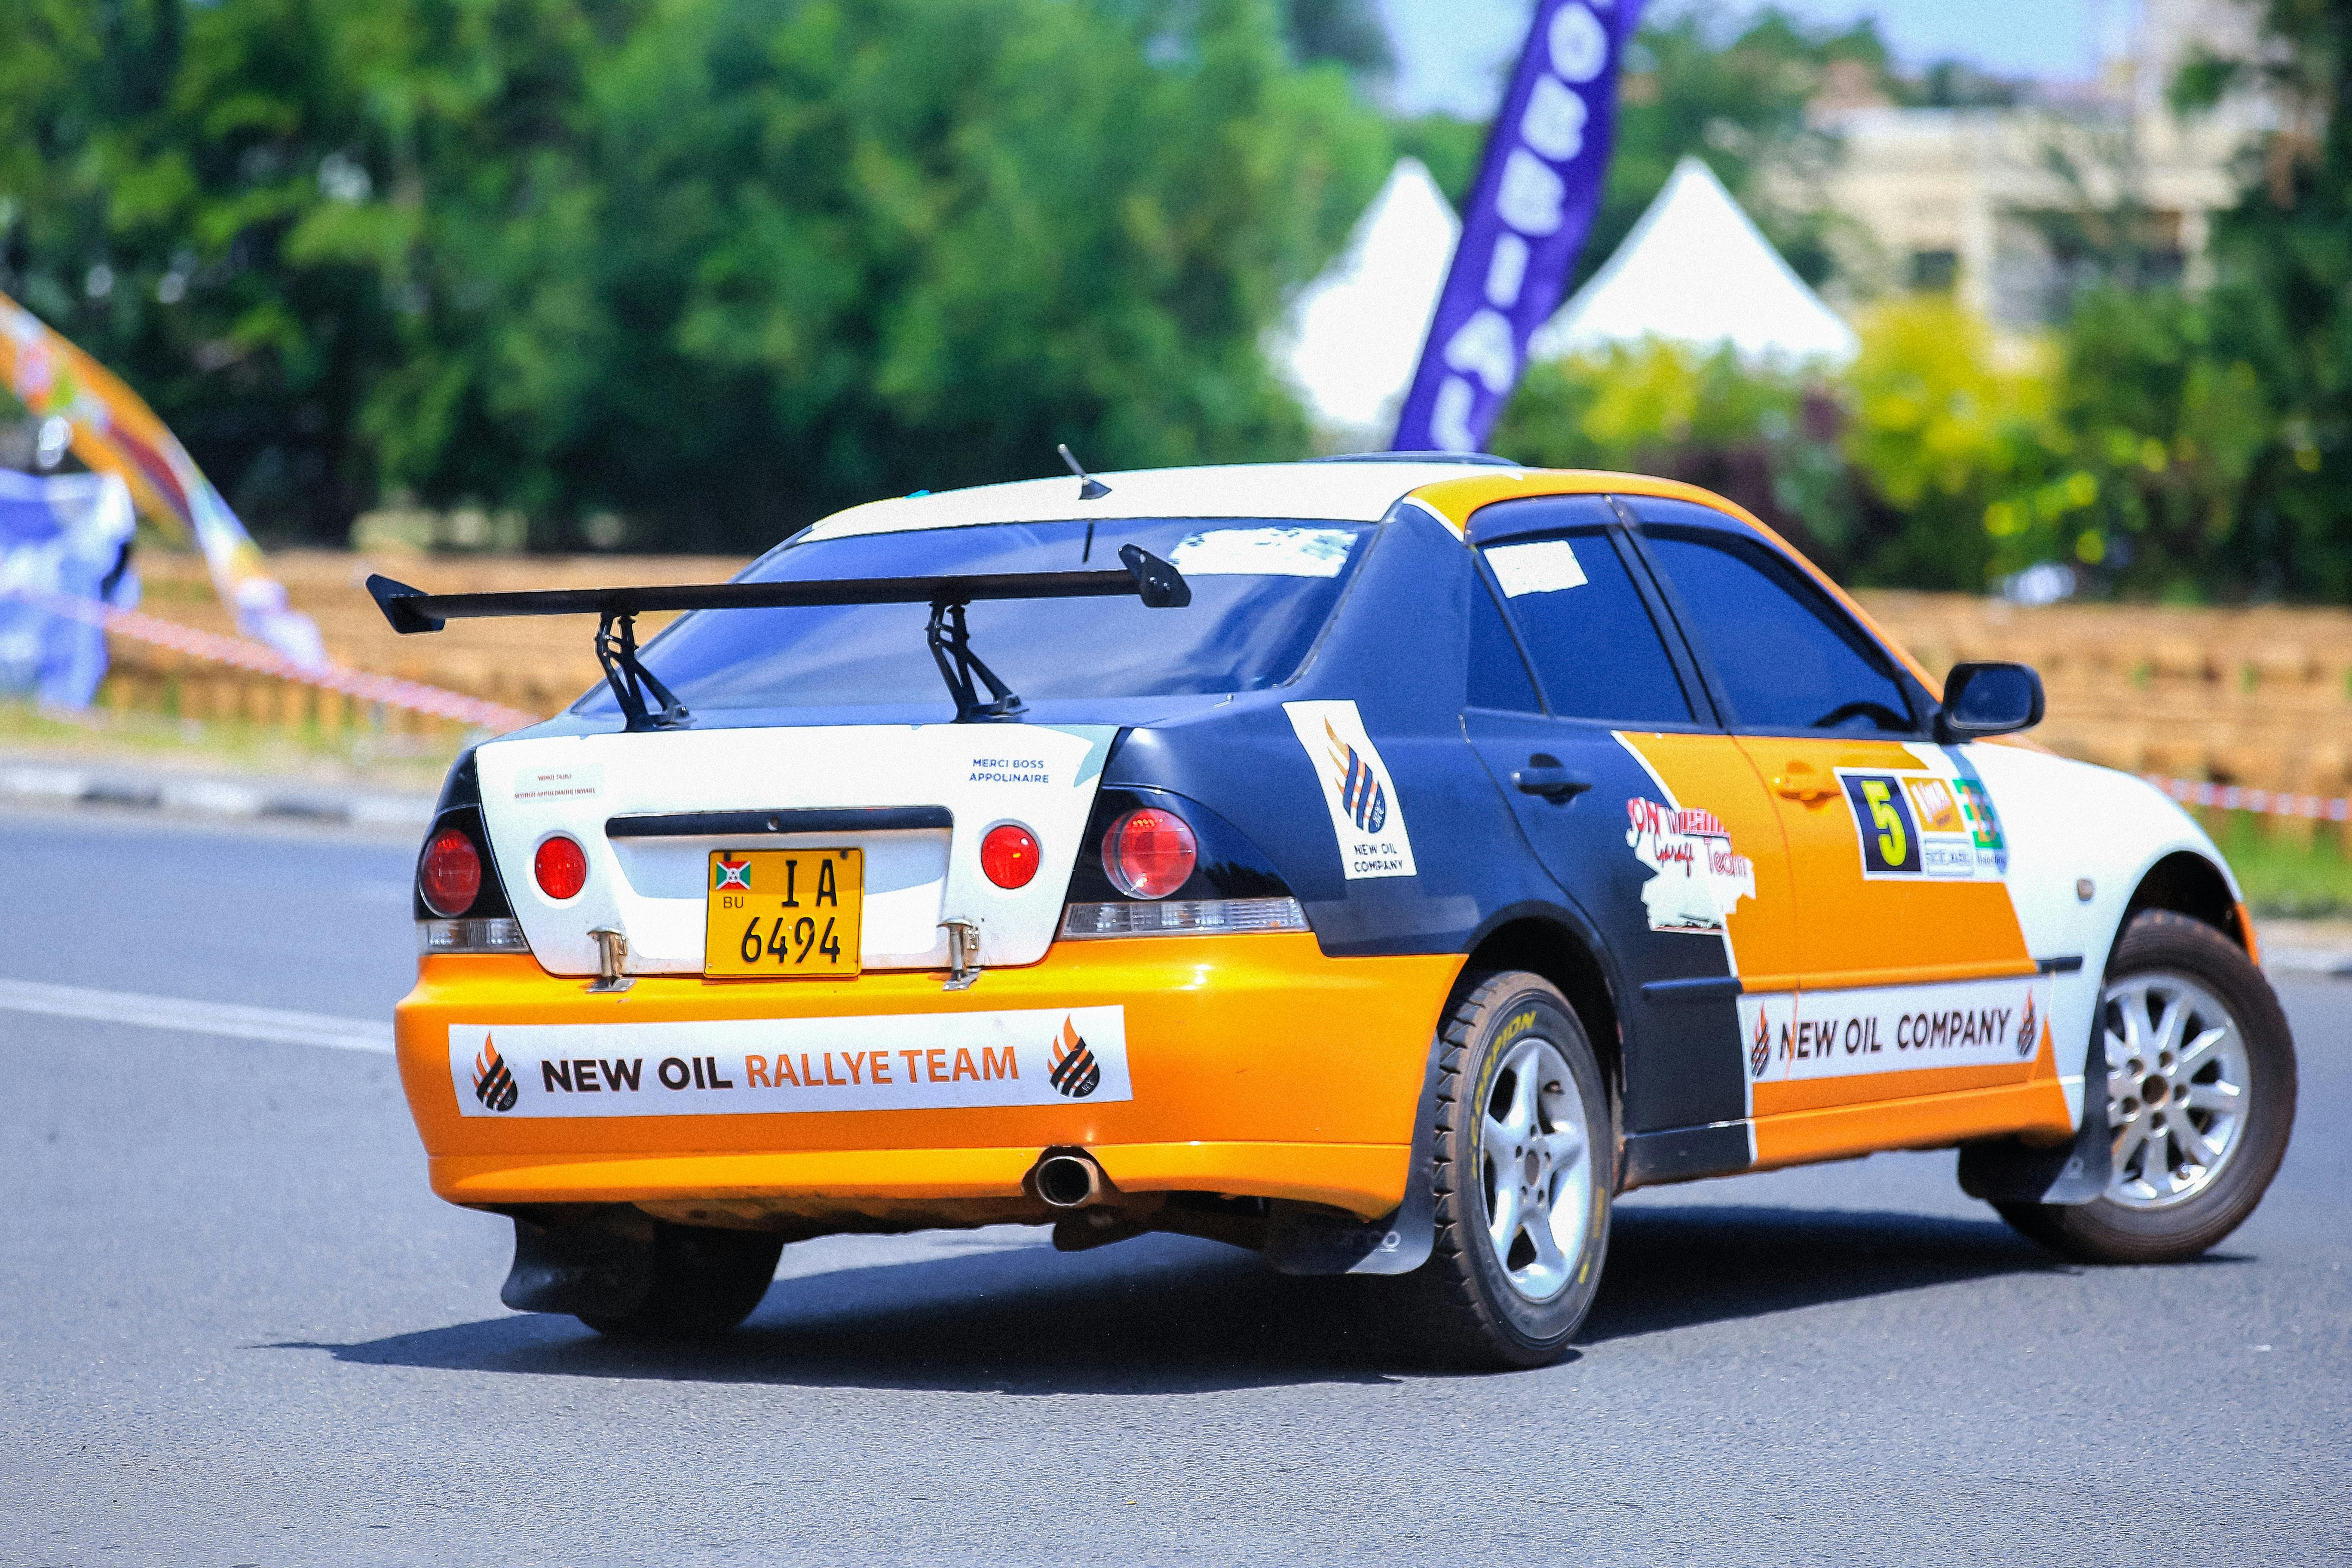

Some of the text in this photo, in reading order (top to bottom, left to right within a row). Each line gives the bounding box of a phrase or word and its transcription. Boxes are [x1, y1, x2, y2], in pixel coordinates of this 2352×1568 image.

[973, 759, 1044, 769] MERCI BOSS
[969, 773, 1049, 783] APPOLINAIRE
[1860, 780, 1907, 867] 5
[1354, 844, 1397, 855] NEW OIL
[1354, 861, 1403, 873] COMPANY
[723, 897, 744, 909] BU
[741, 917, 840, 964] 6494
[1779, 1008, 2011, 1061] NEW OIL COMPANY
[541, 1046, 1019, 1093] NEW OIL RALLYE TEAM
